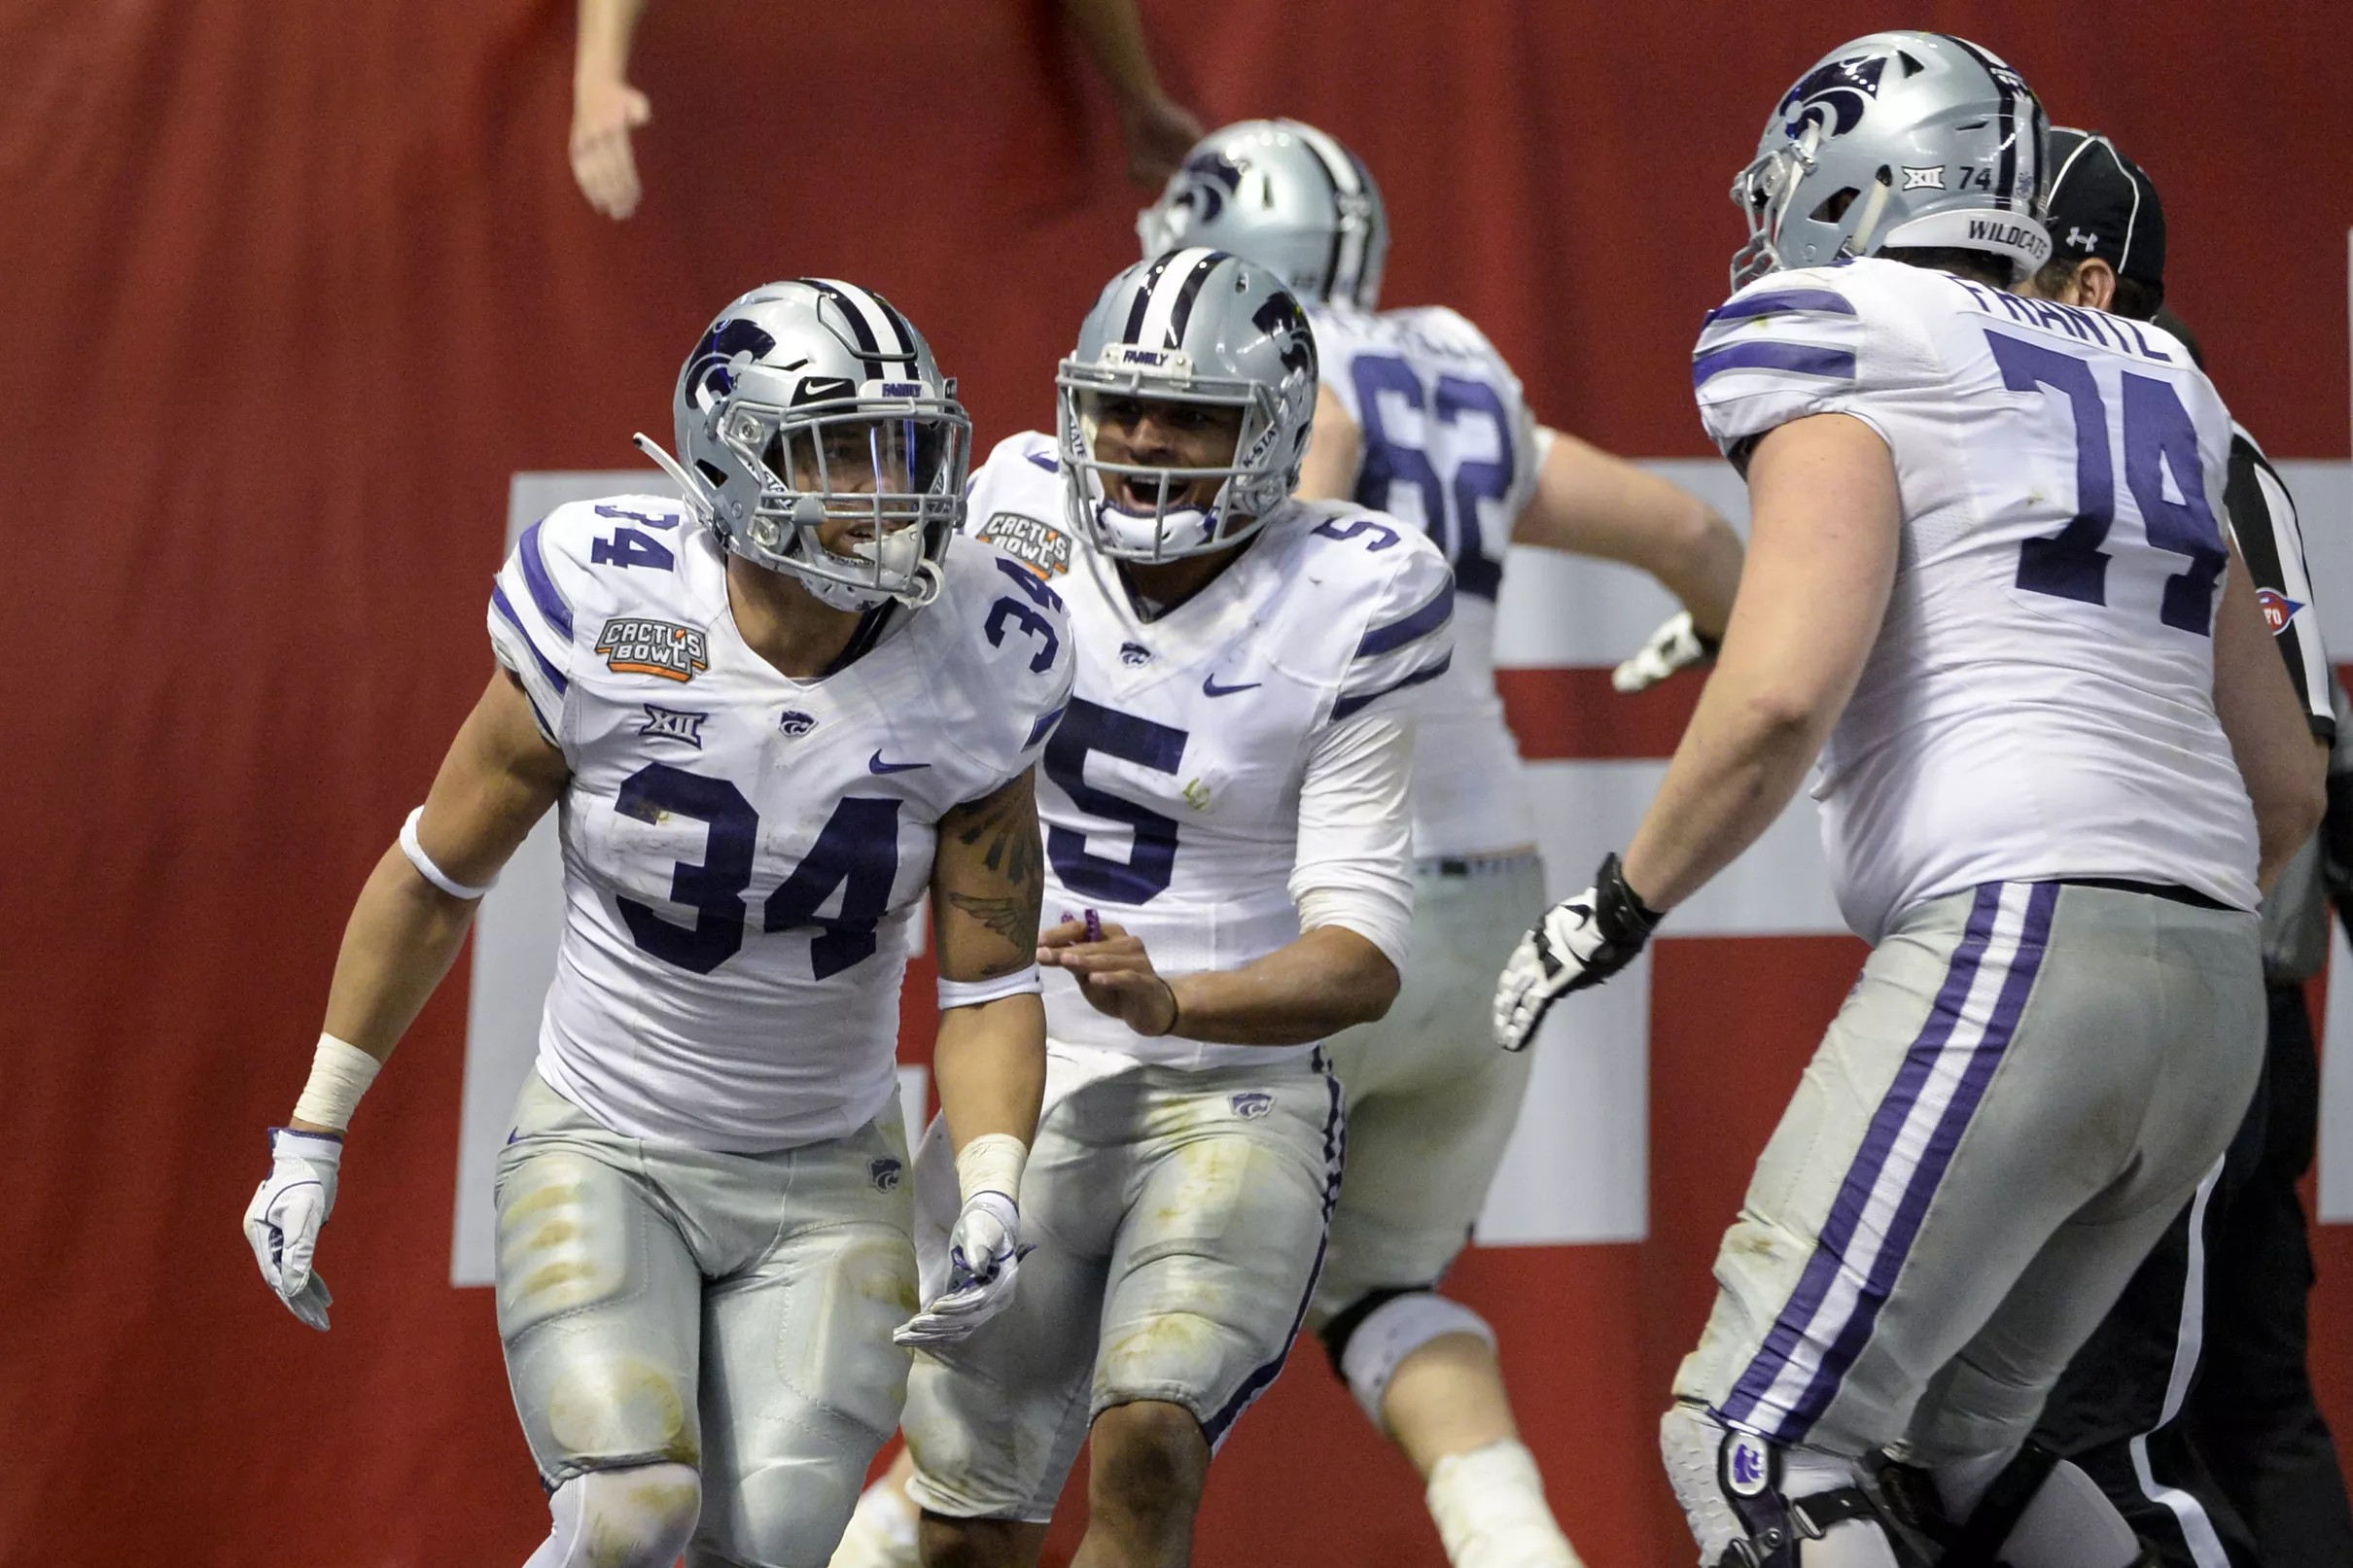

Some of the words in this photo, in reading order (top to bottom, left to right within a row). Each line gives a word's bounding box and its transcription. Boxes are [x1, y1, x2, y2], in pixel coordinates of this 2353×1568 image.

[1959, 166, 1991, 191] 74
[1969, 221, 2048, 260] WILDCATS
[1123, 350, 1168, 366] FAMILY
[1351, 355, 1514, 604] 62
[1984, 329, 2229, 637] 74
[987, 515, 1067, 561] CACTUS
[1312, 517, 1400, 552] 5
[984, 557, 1063, 674] 34
[605, 623, 701, 658] CACTUS
[615, 645, 686, 670] BOWL
[1043, 696, 1189, 905] 5
[615, 762, 904, 981] 34
